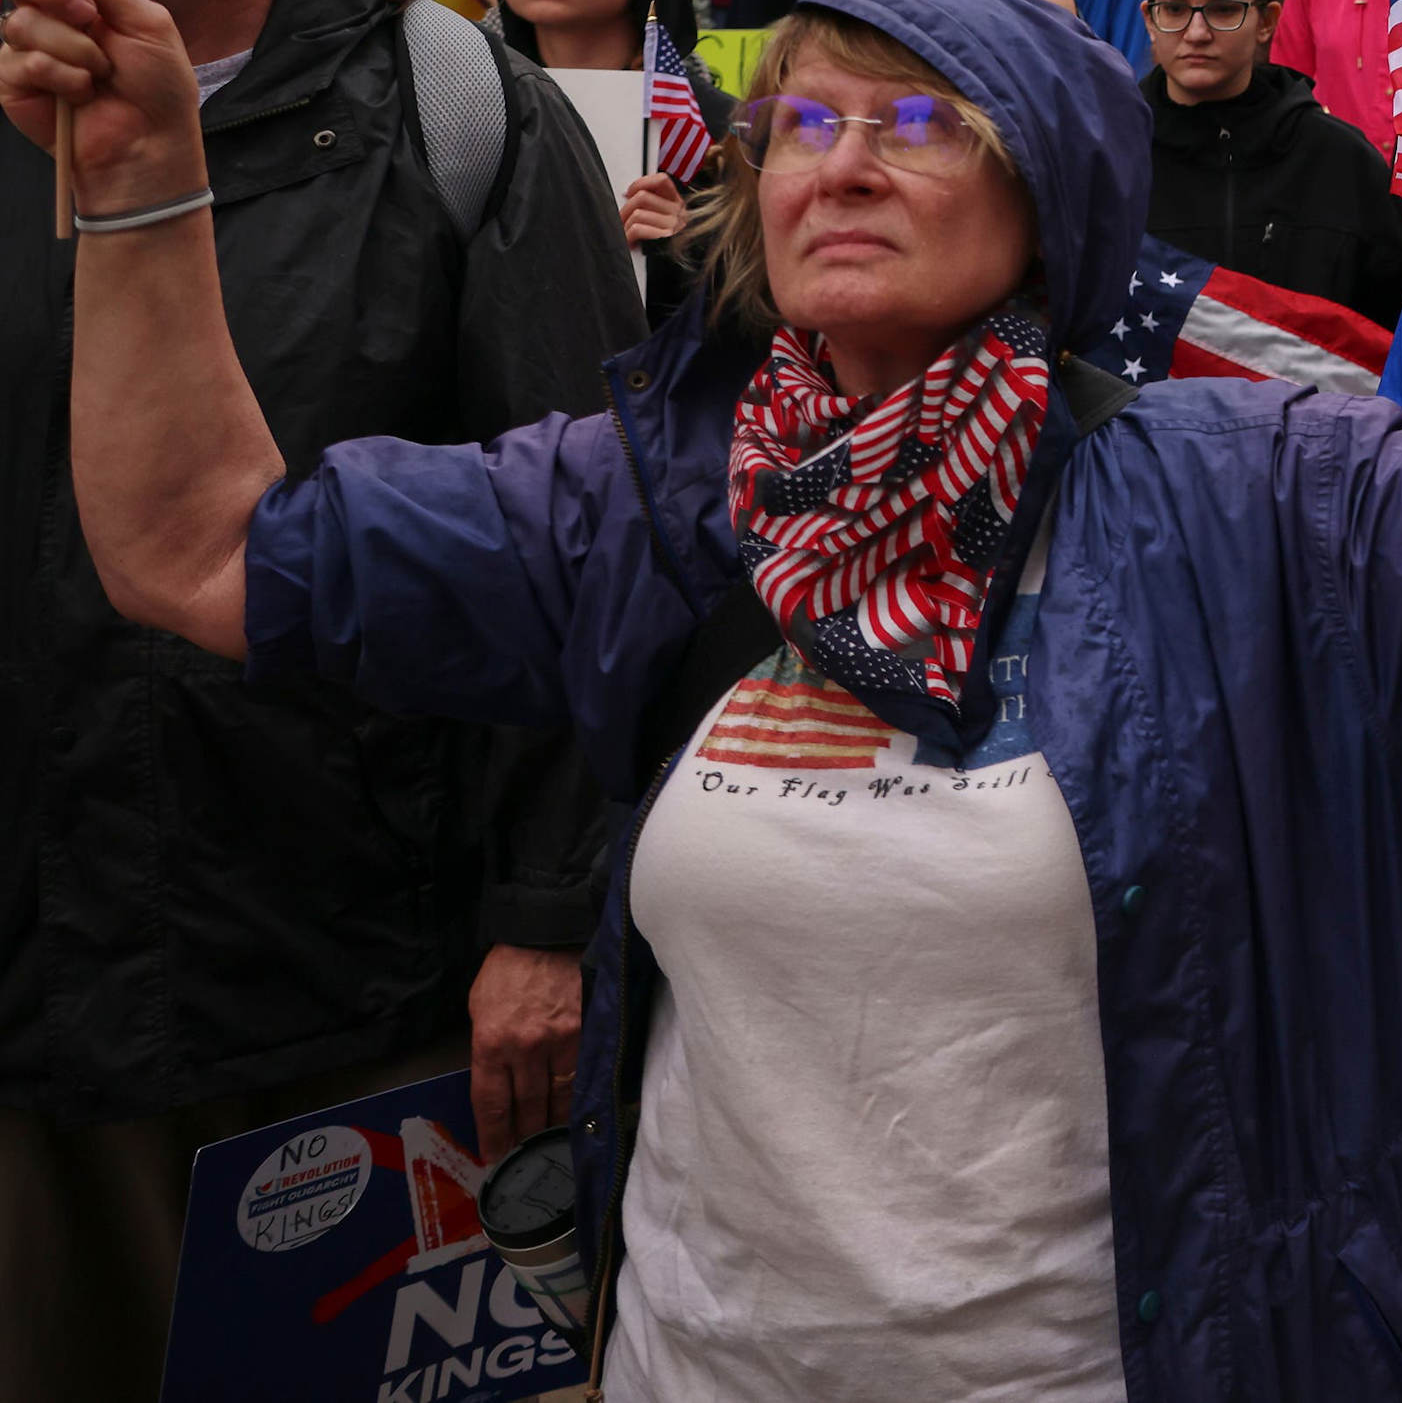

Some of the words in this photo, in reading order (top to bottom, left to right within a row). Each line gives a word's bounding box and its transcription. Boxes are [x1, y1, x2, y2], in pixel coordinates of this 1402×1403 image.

[777, 777, 849, 807] Flag
[866, 774, 932, 800] Was
[949, 766, 1032, 792] Still
[279, 1134, 328, 1171] NO
[281, 1153, 362, 1189] REVOLUTION
